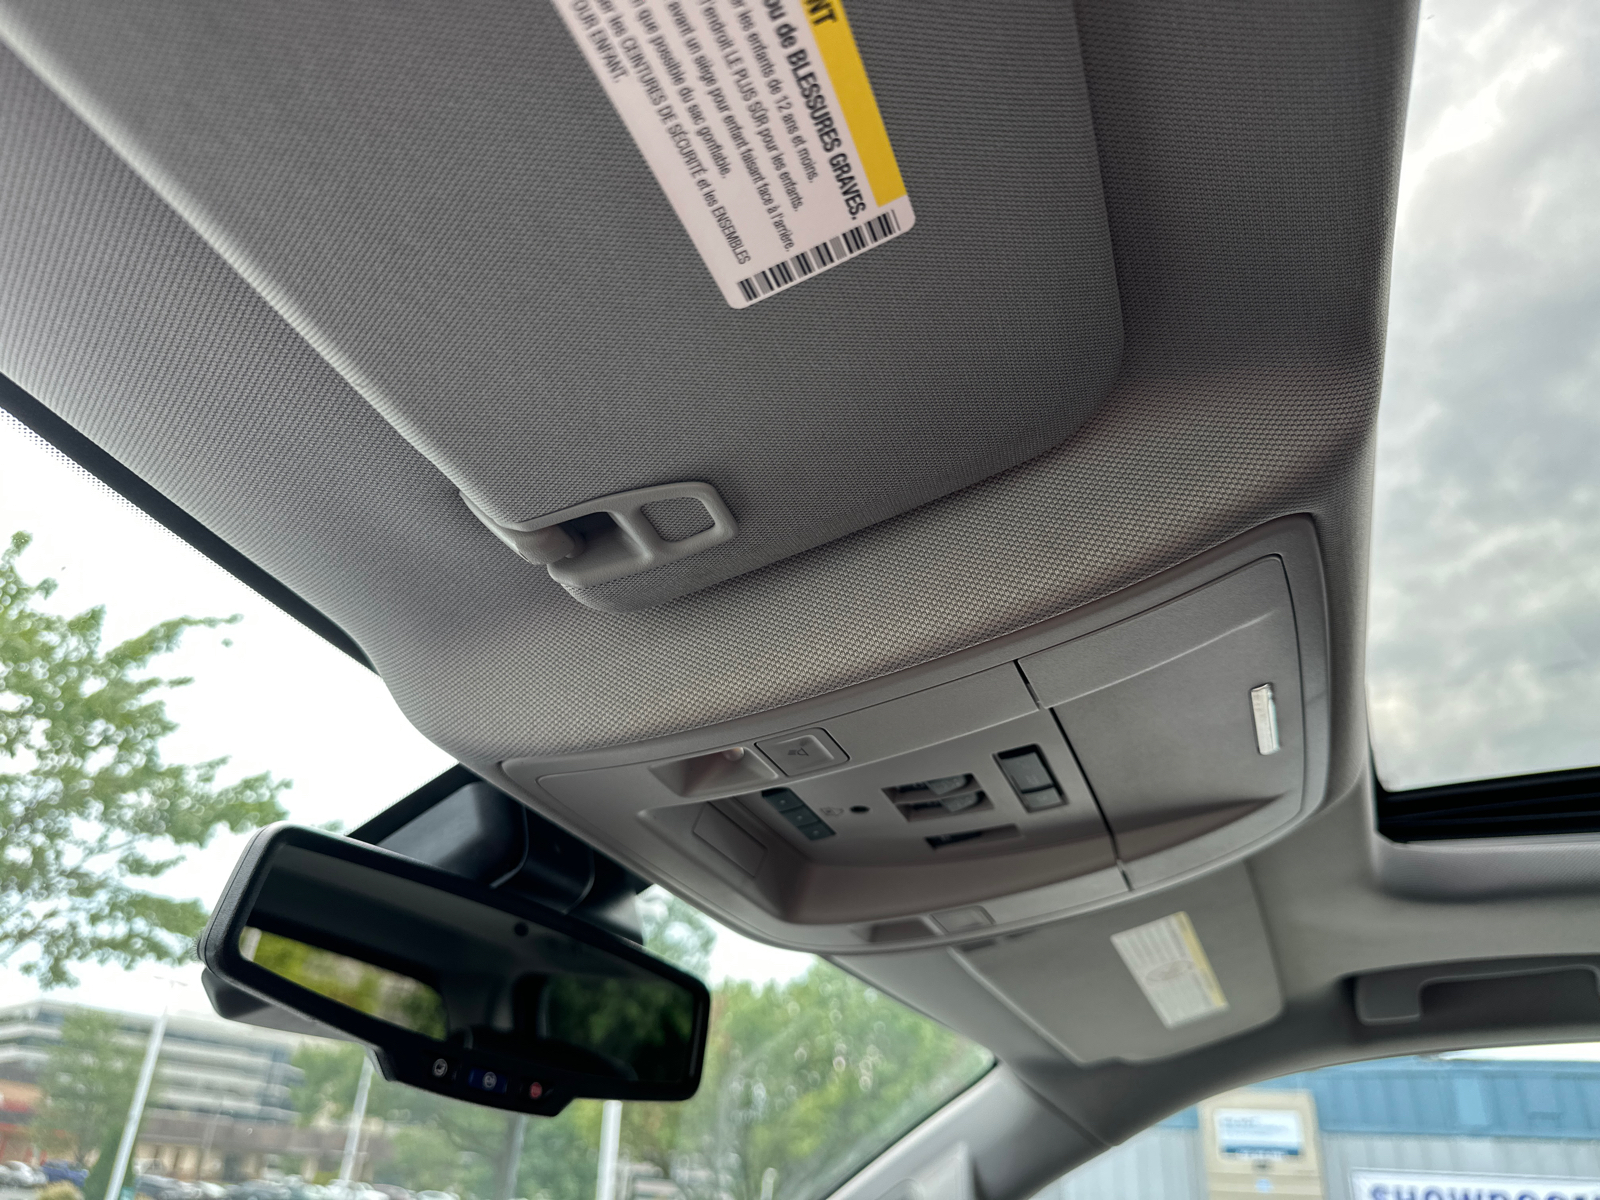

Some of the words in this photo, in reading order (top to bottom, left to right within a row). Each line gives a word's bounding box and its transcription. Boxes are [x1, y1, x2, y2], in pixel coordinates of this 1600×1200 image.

[608, 14, 630, 38] les
[634, 7, 660, 36] que
[667, 0, 695, 37] avant
[736, 8, 757, 32] les
[685, 35, 702, 55] un
[773, 19, 801, 50] de
[648, 32, 689, 87] possible
[724, 49, 743, 69] LE
[746, 30, 778, 79] enfants
[620, 35, 668, 106] CEINTURES
[693, 52, 721, 89] siège
[732, 66, 758, 103] PLUS
[678, 83, 697, 104] du
[767, 76, 785, 95] de
[785, 46, 844, 154] BLESSURES
[657, 103, 677, 125] DE
[686, 102, 706, 126] sac
[705, 85, 732, 116] pour
[746, 98, 771, 128] SÛR
[774, 93, 793, 114] 12
[723, 112, 750, 150] enfant
[781, 112, 799, 136] ans
[667, 121, 709, 179] SÉCURITÉ
[695, 123, 734, 179] gonflable.
[754, 126, 778, 155] pour
[791, 132, 806, 148] et
[739, 147, 766, 185] faisant
[771, 152, 788, 172] les
[796, 146, 820, 183] moins.
[696, 177, 711, 190] et
[702, 188, 721, 207] les
[756, 181, 776, 207] face
[778, 168, 805, 212] enfants.
[828, 150, 869, 221] GRAVES.
[766, 203, 780, 215] à
[711, 204, 751, 265] ENSEMBLES
